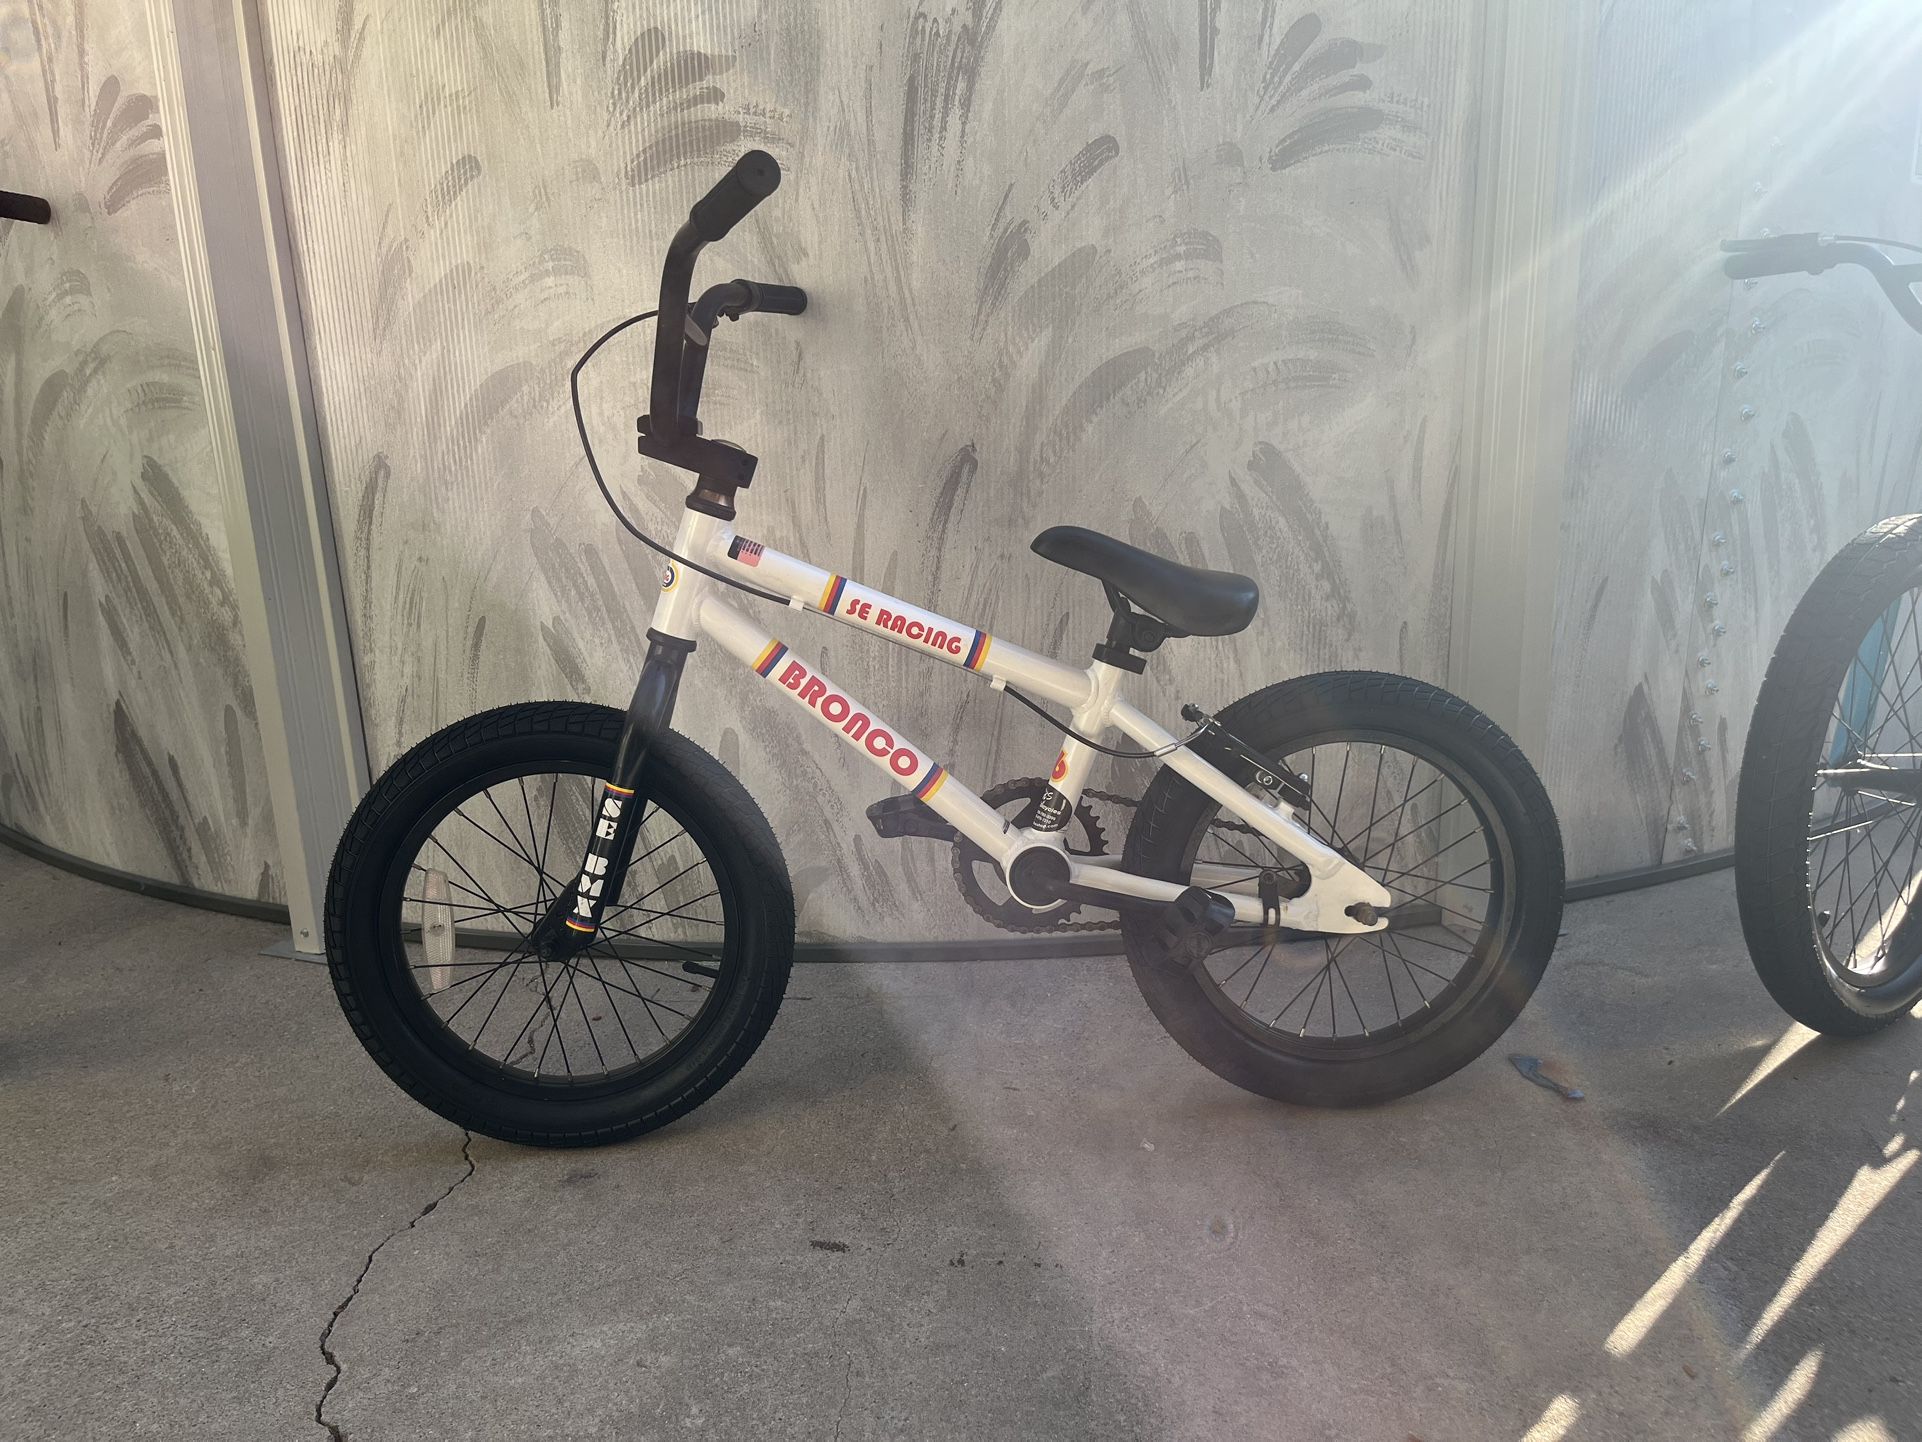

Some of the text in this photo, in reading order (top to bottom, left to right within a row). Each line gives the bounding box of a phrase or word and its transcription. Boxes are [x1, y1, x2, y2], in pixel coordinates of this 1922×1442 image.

[846, 598, 962, 655] SE RACING
[778, 660, 919, 777] BRONCO
[572, 797, 623, 918] SE BMX
